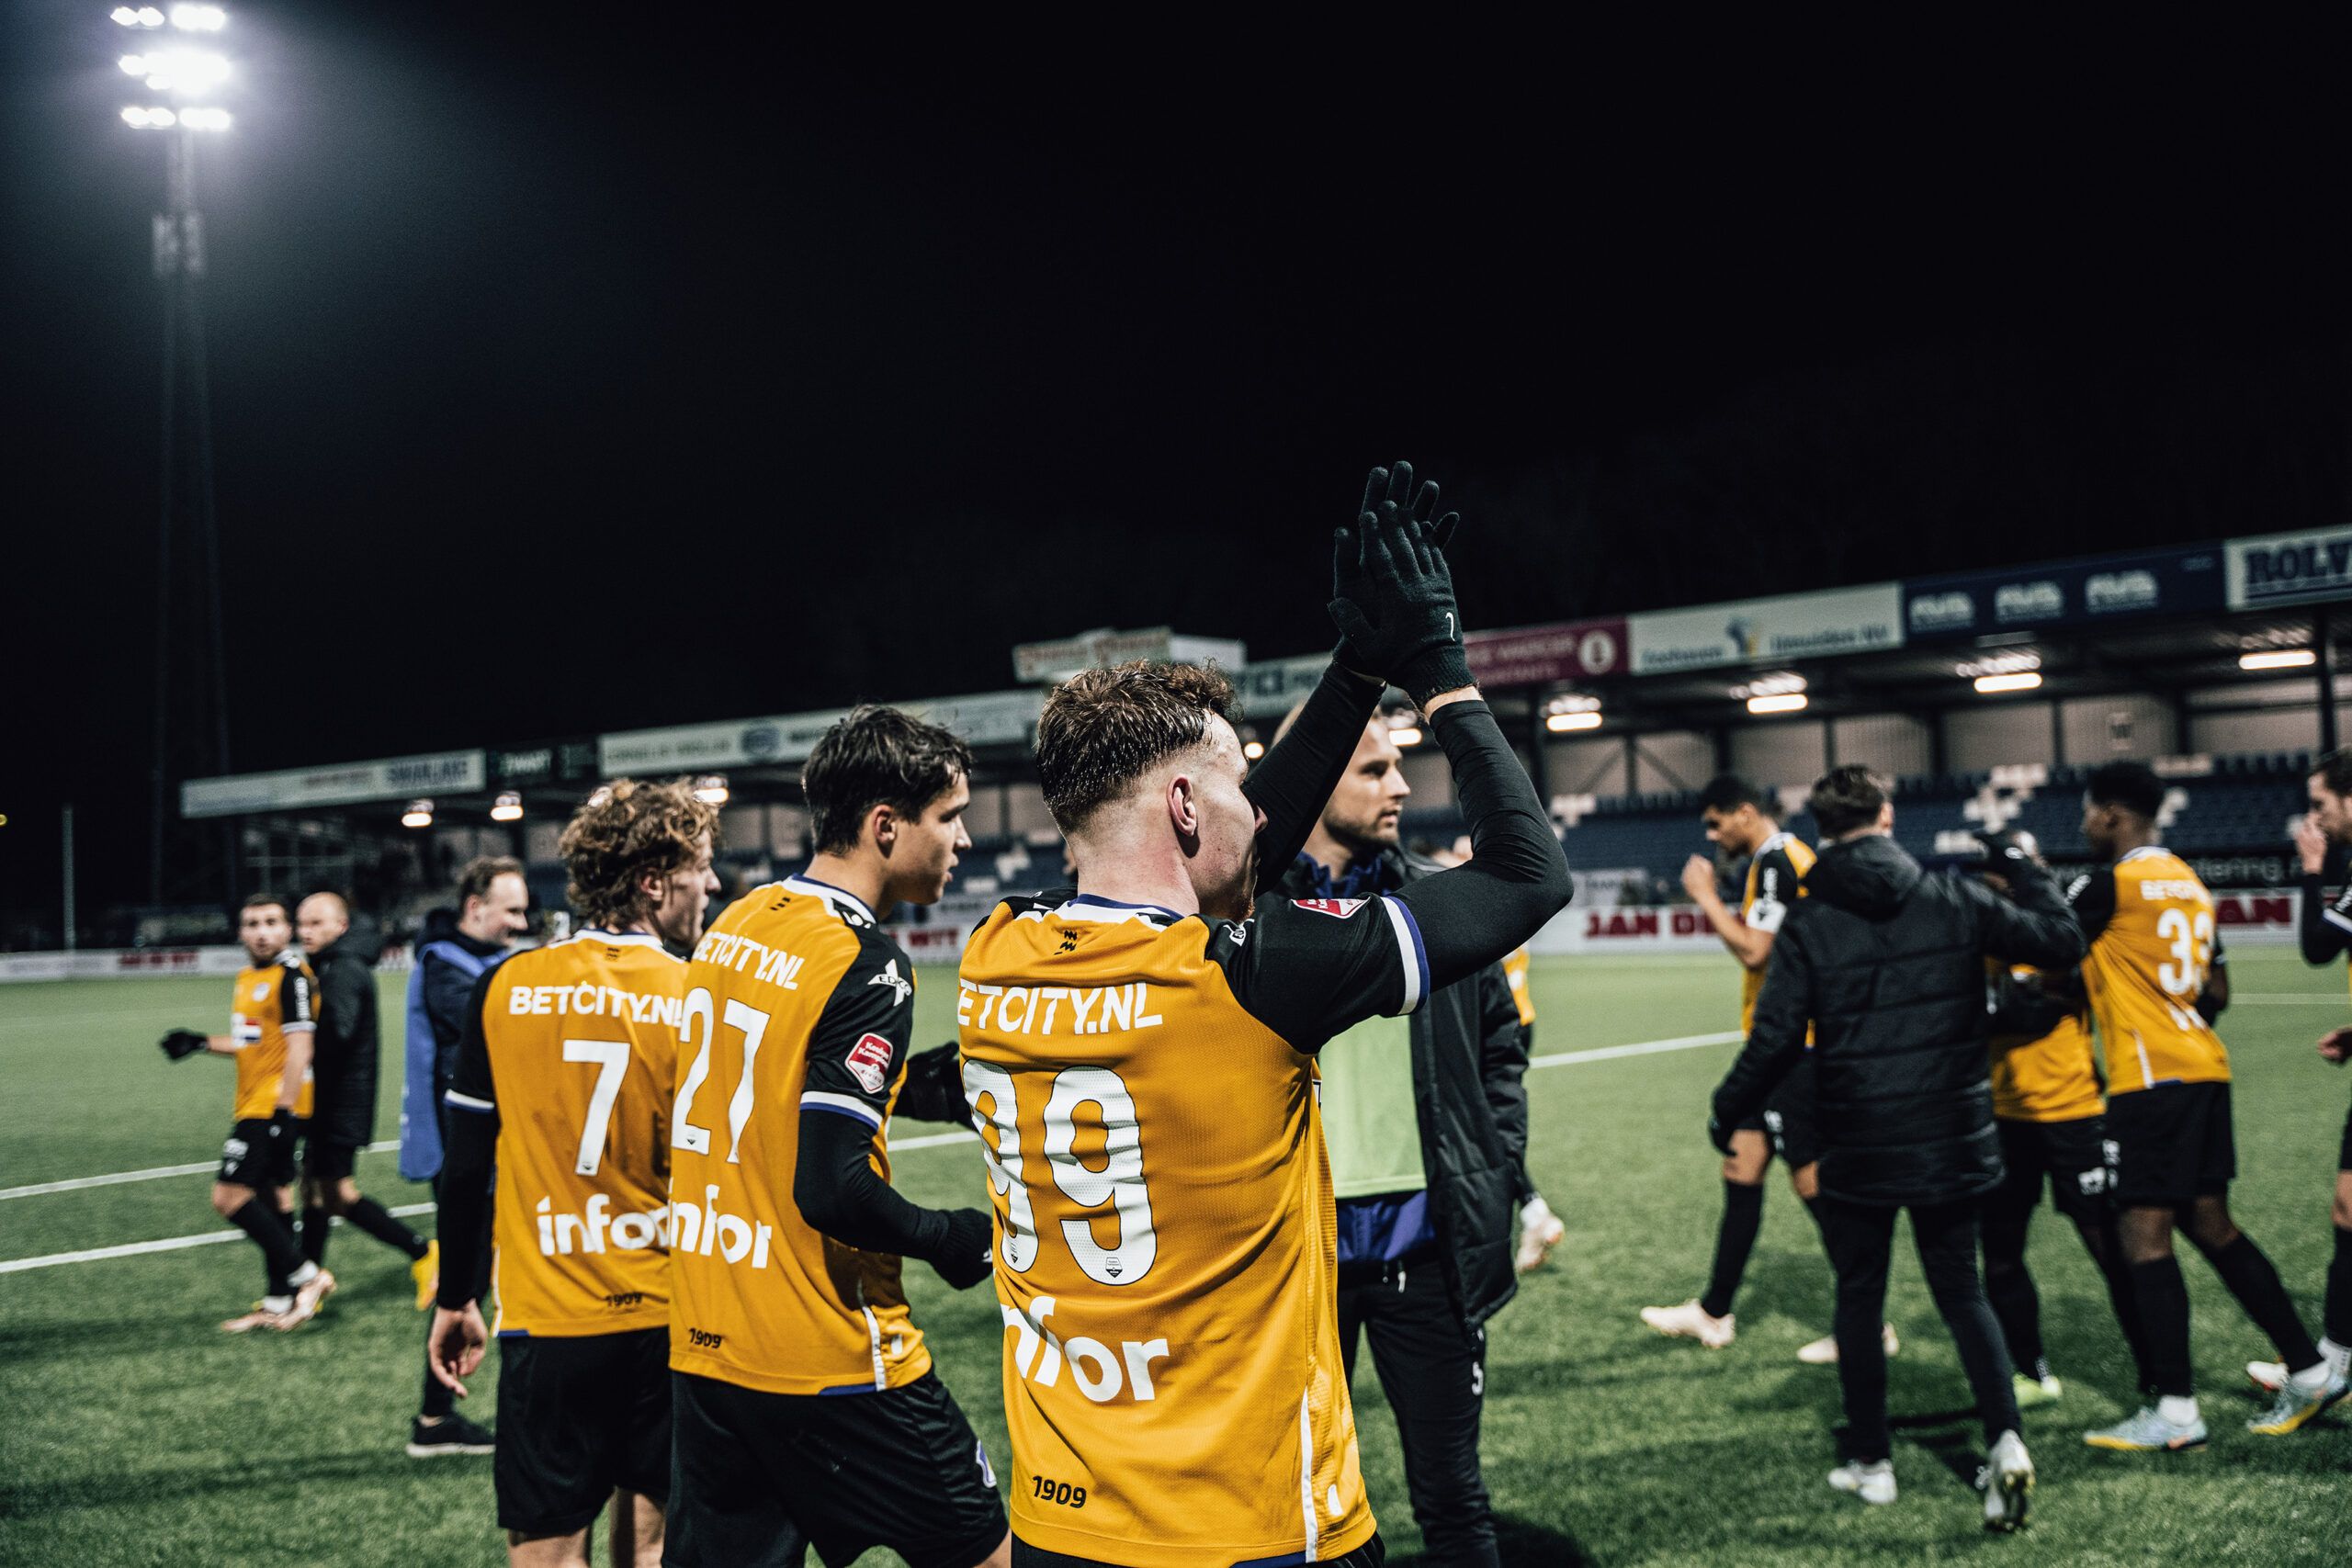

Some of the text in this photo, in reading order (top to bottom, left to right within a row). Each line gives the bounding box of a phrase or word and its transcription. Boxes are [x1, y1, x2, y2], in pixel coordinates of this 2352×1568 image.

[2216, 896, 2291, 924] AN
[957, 978, 1163, 1035] ETCITY.NL
[562, 1039, 631, 1177] 7
[671, 987, 771, 1164] 27
[962, 1058, 1158, 1286] 99
[688, 1326, 723, 1349] 1909
[1000, 1295, 1170, 1403] nfor
[1032, 1475, 1087, 1509] 1909
